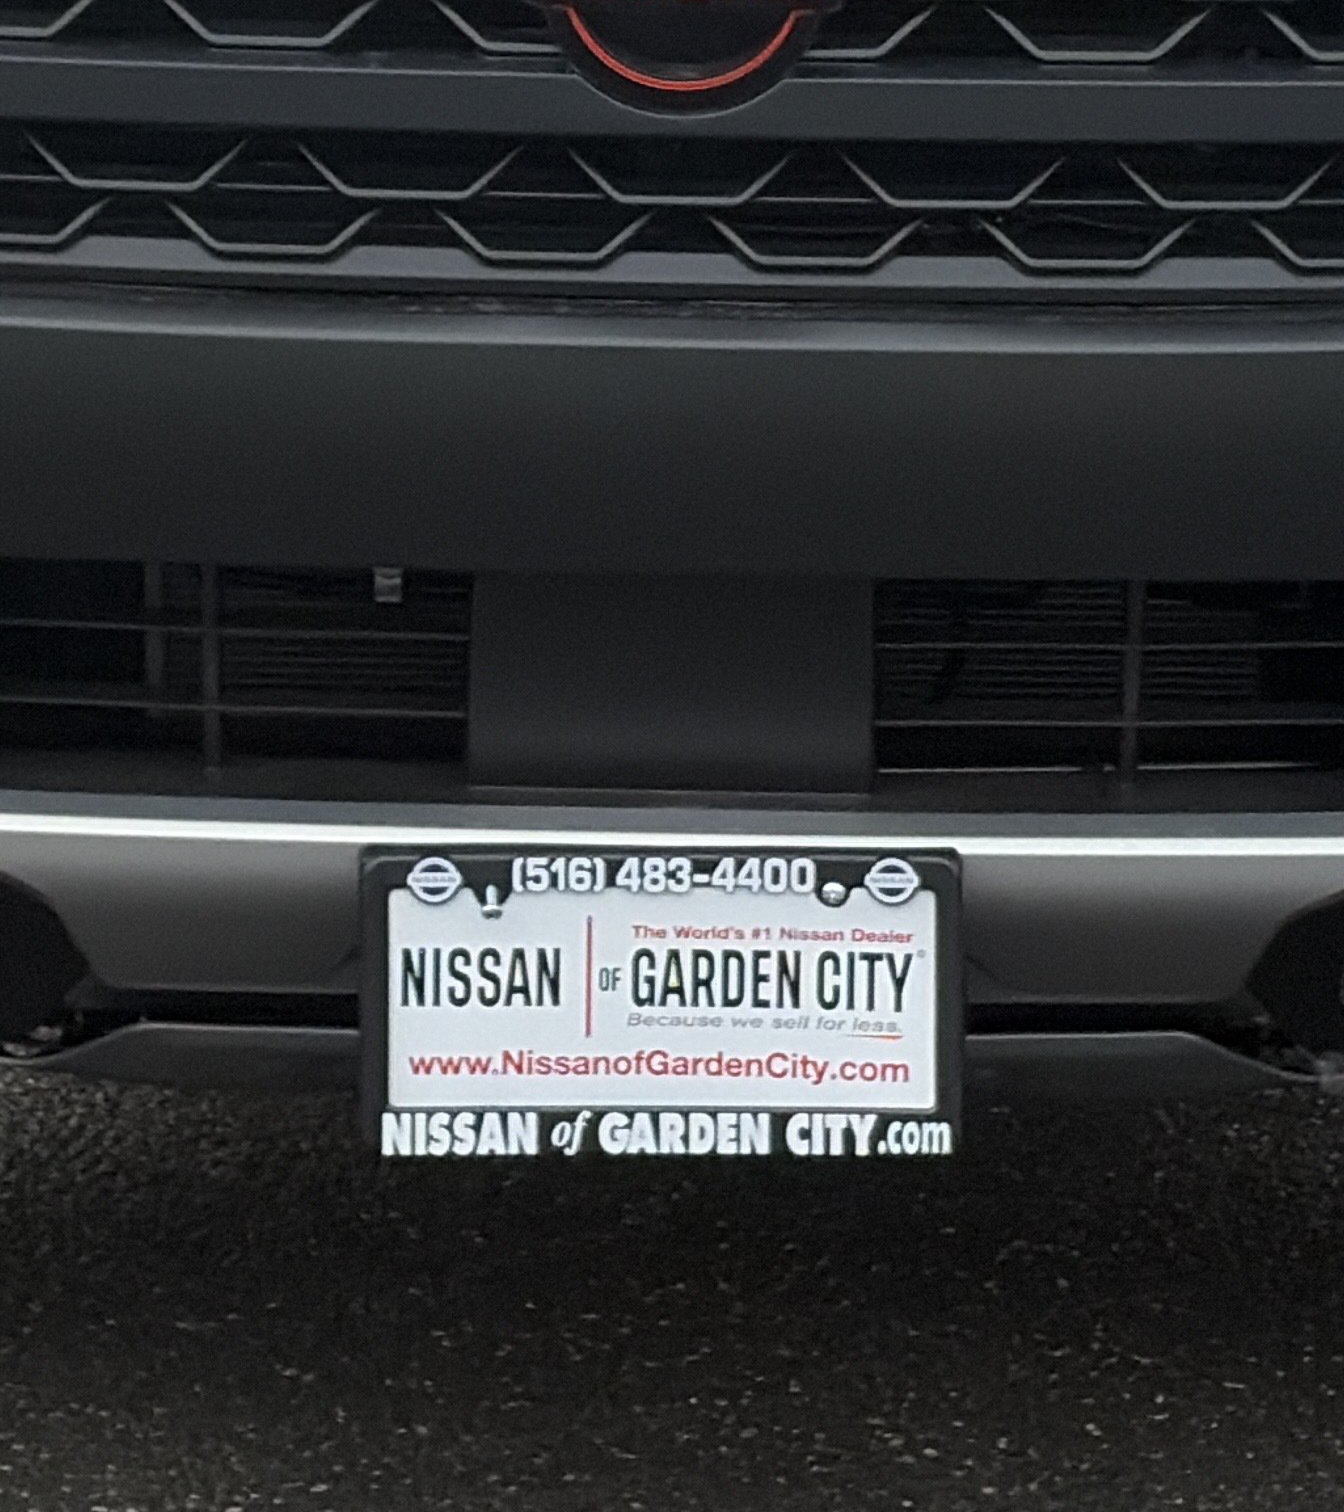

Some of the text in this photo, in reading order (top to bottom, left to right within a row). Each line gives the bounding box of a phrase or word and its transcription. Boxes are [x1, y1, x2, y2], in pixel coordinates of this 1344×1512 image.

[511, 856, 817, 895] (516) 483-4400
[632, 925, 914, 944] The World's #1 Nissan Dealer
[400, 947, 914, 1013] NISSAN OF GARDEN CITY
[627, 1013, 903, 1033] Because we sell for less.
[409, 1050, 910, 1085] www.NissanofGardenCity.com
[381, 1110, 953, 1157] NISSAN of GARDEN CITY.com
